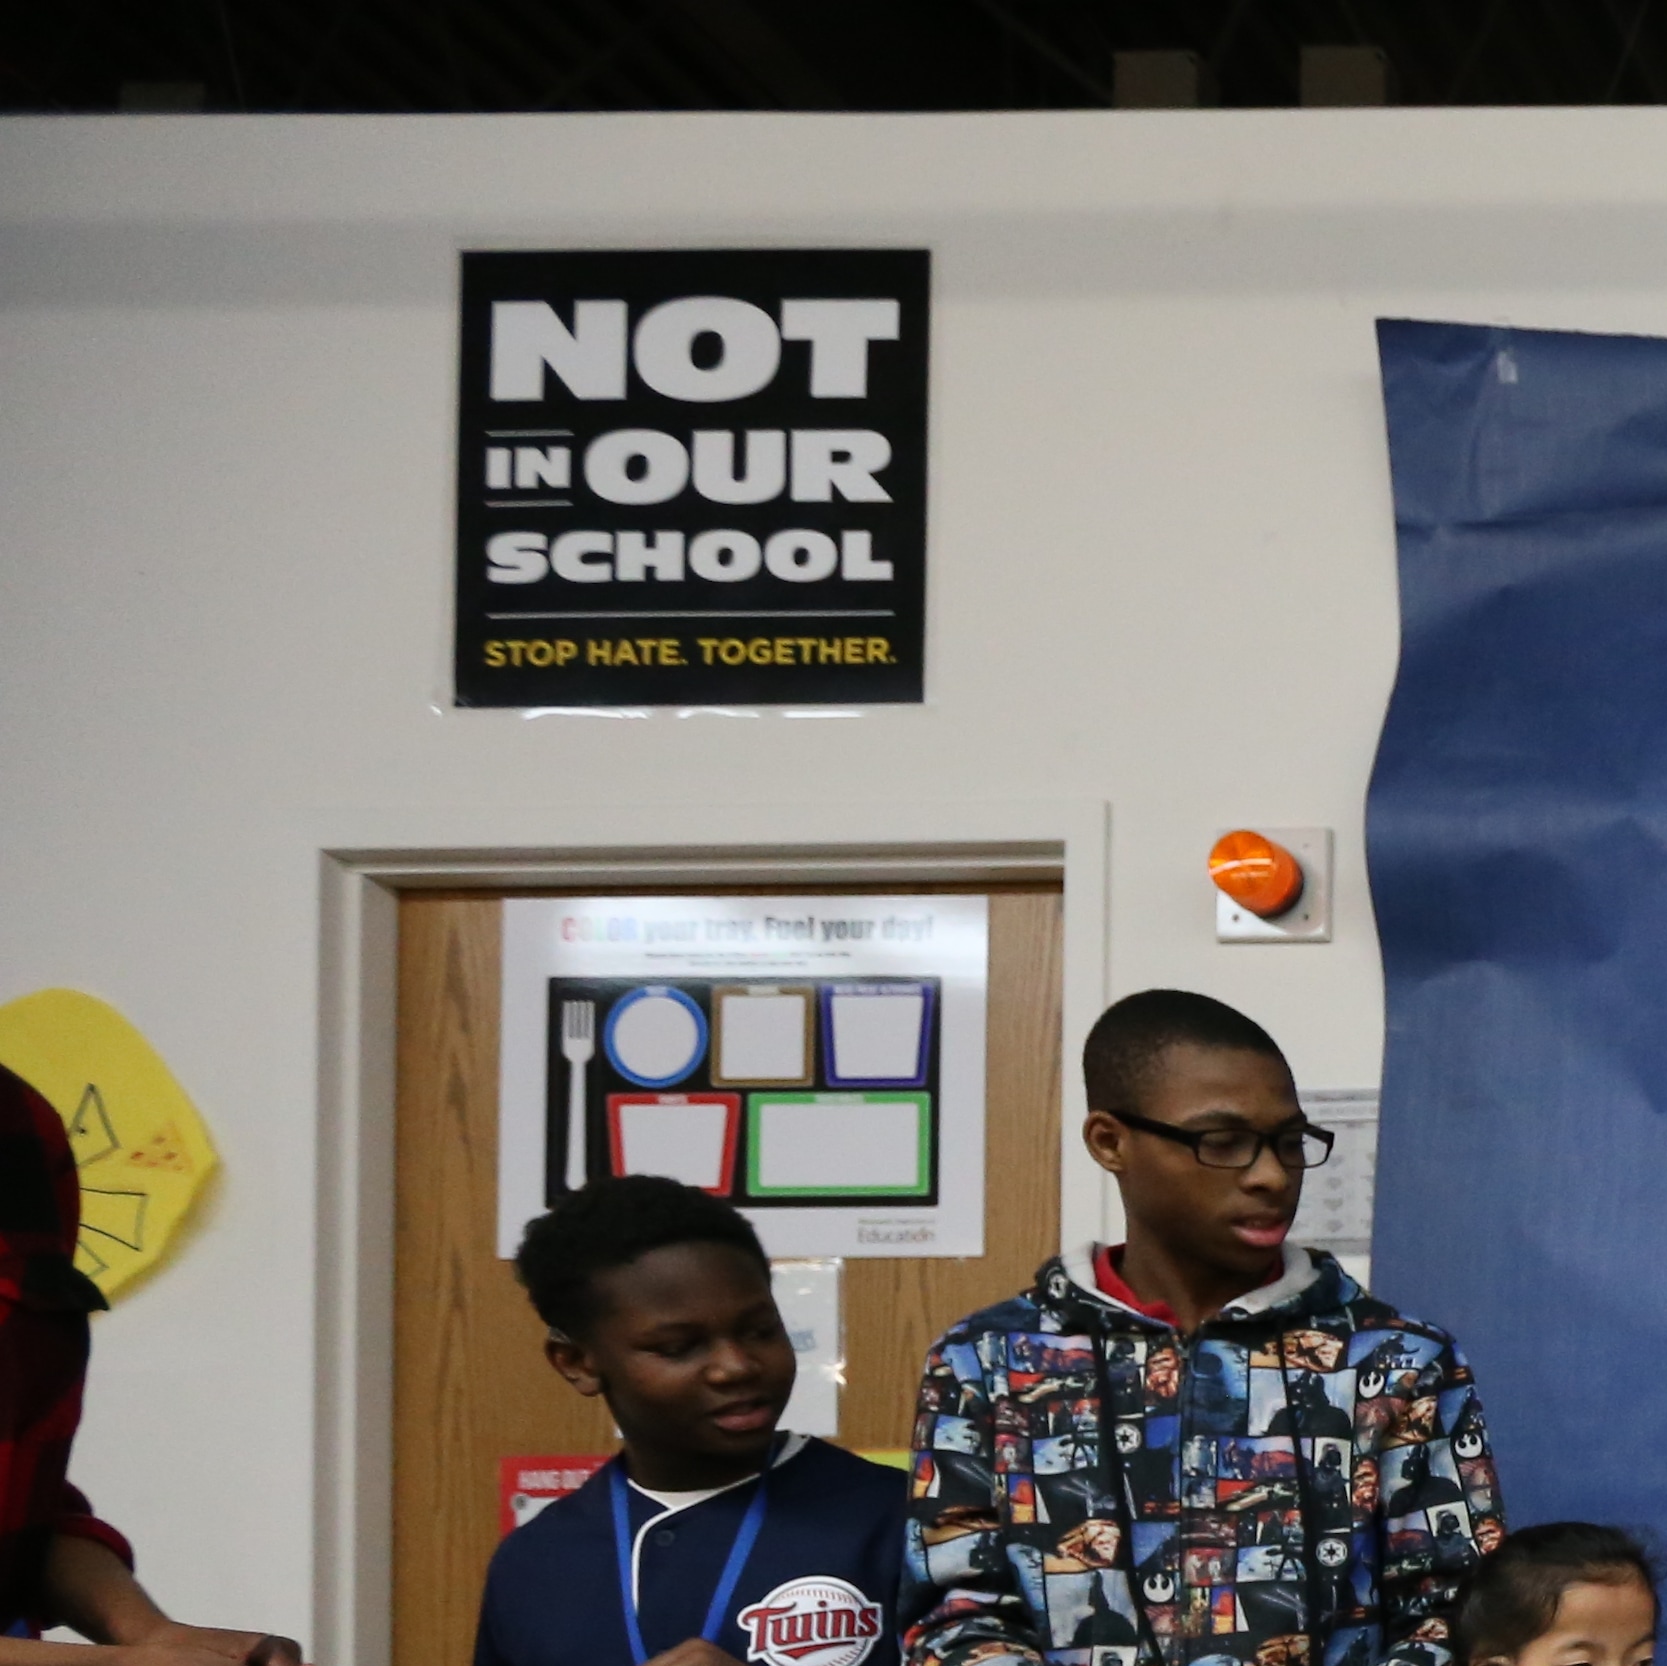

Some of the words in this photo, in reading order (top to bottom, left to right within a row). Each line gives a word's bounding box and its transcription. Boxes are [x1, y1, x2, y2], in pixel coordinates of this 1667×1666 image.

[490, 296, 900, 402] NOT
[485, 447, 572, 489] IN
[584, 428, 894, 505] OUR
[486, 529, 894, 584] SCHOOL
[485, 640, 578, 667] STOP
[586, 639, 689, 667] HATE.
[698, 637, 898, 666] TOGETHER.
[764, 915, 814, 942] Fuel
[820, 917, 875, 944] your
[742, 1600, 878, 1654] Twins
